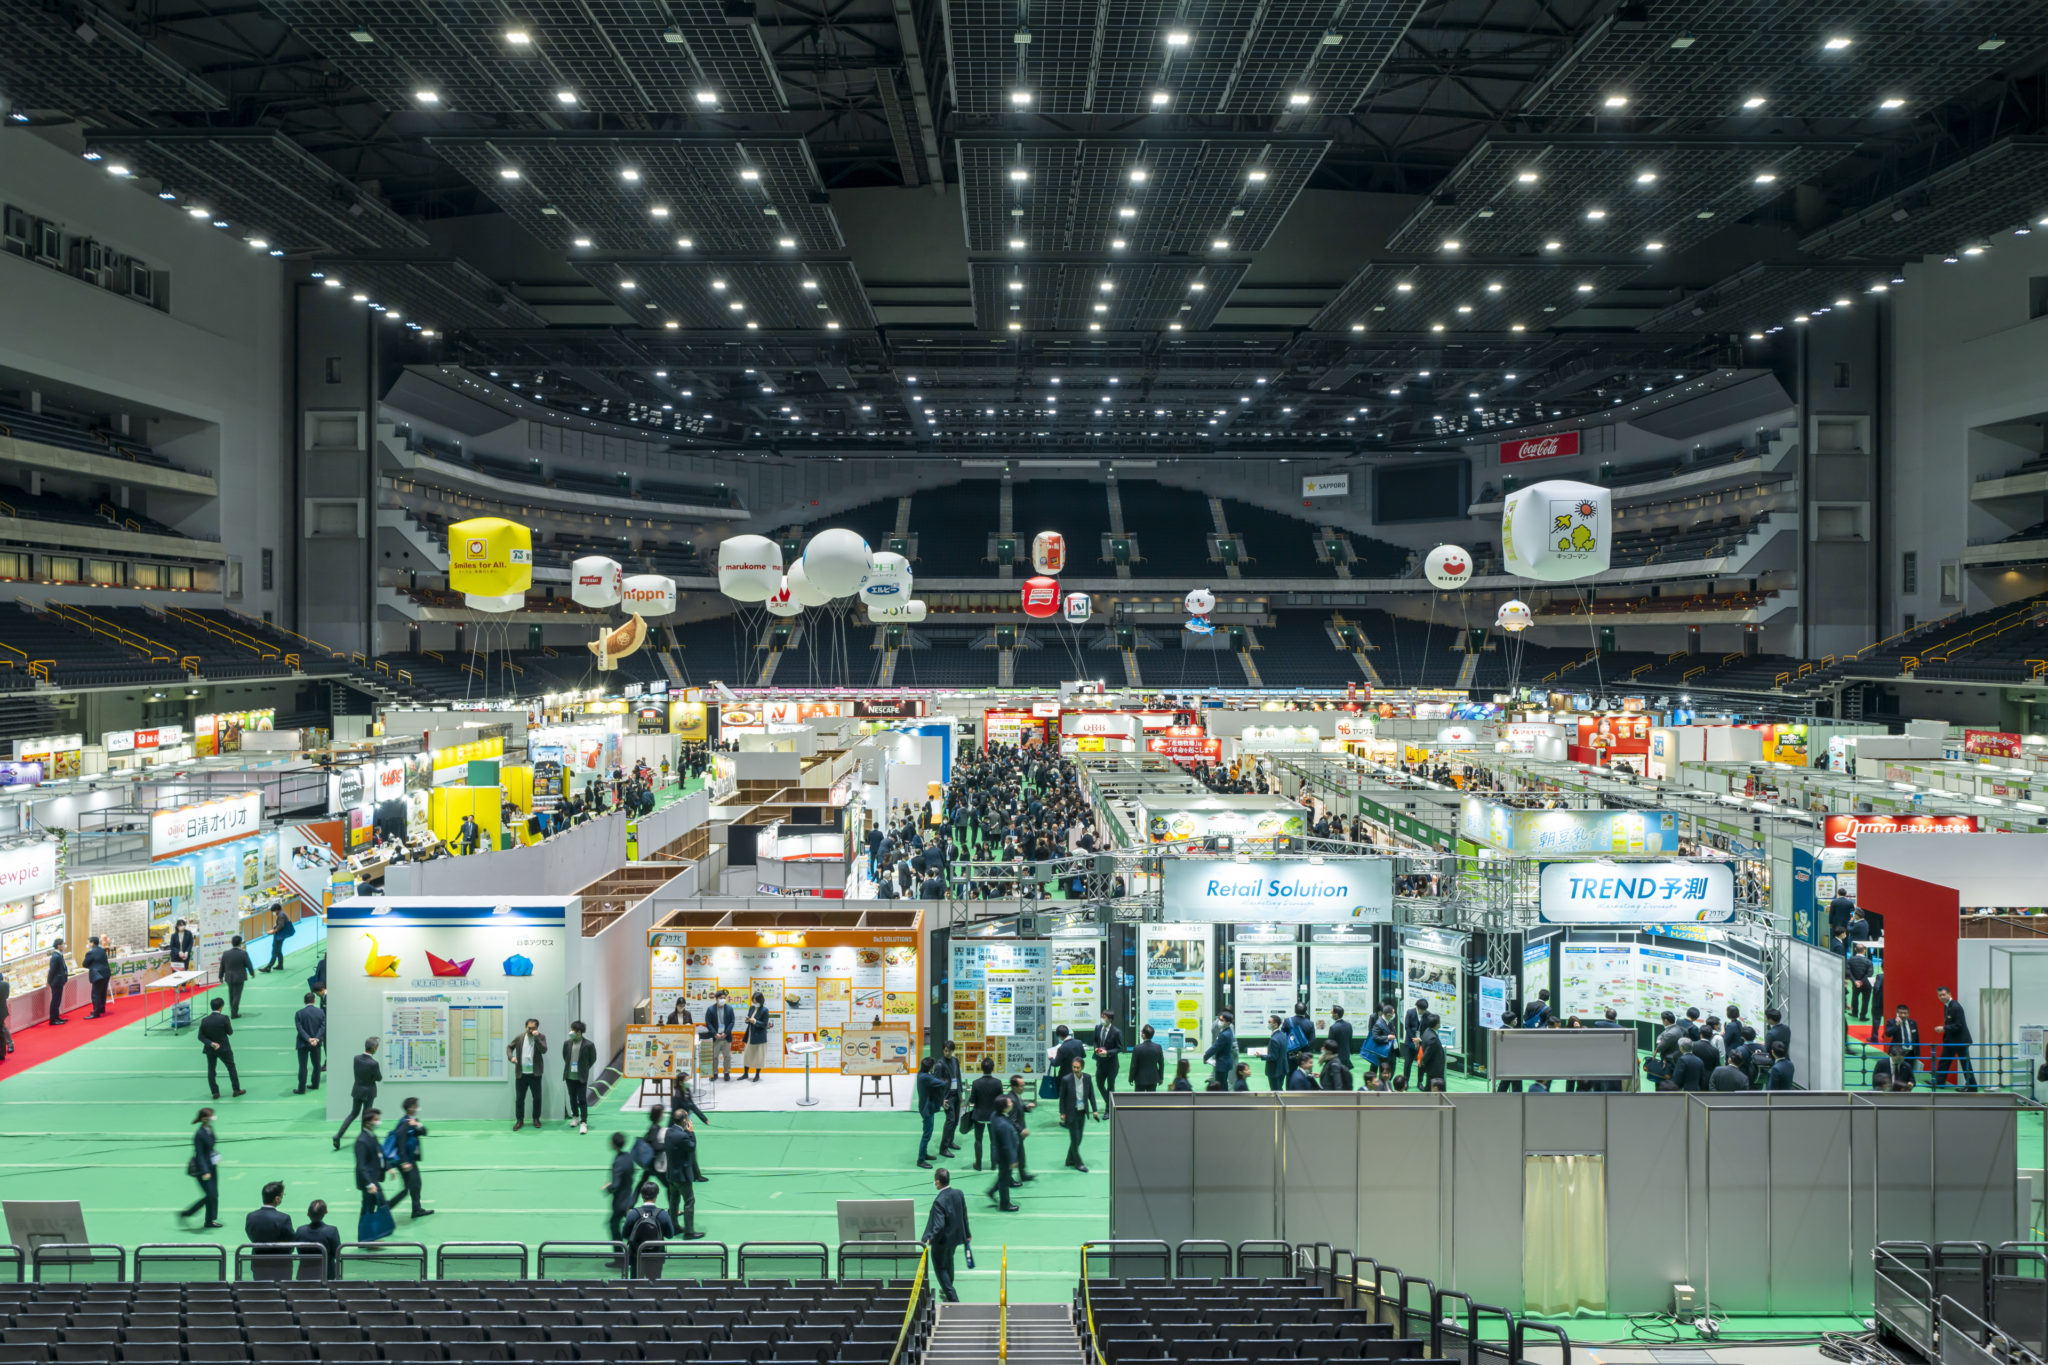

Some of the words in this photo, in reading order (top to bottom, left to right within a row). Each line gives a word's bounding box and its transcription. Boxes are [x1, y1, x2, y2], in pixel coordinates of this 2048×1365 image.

[1518, 437, 1560, 459] Coca-Cola
[1318, 482, 1346, 490] SAPPORO
[725, 562, 767, 571] marukome
[624, 588, 665, 602] nippn
[871, 586, 897, 594] エルビー
[187, 808, 247, 838] 日清オイリオ
[0, 864, 40, 886] ewpie
[1206, 879, 1263, 896] Retail
[1268, 879, 1348, 897] Solution
[1569, 877, 1709, 900] TREND予測
